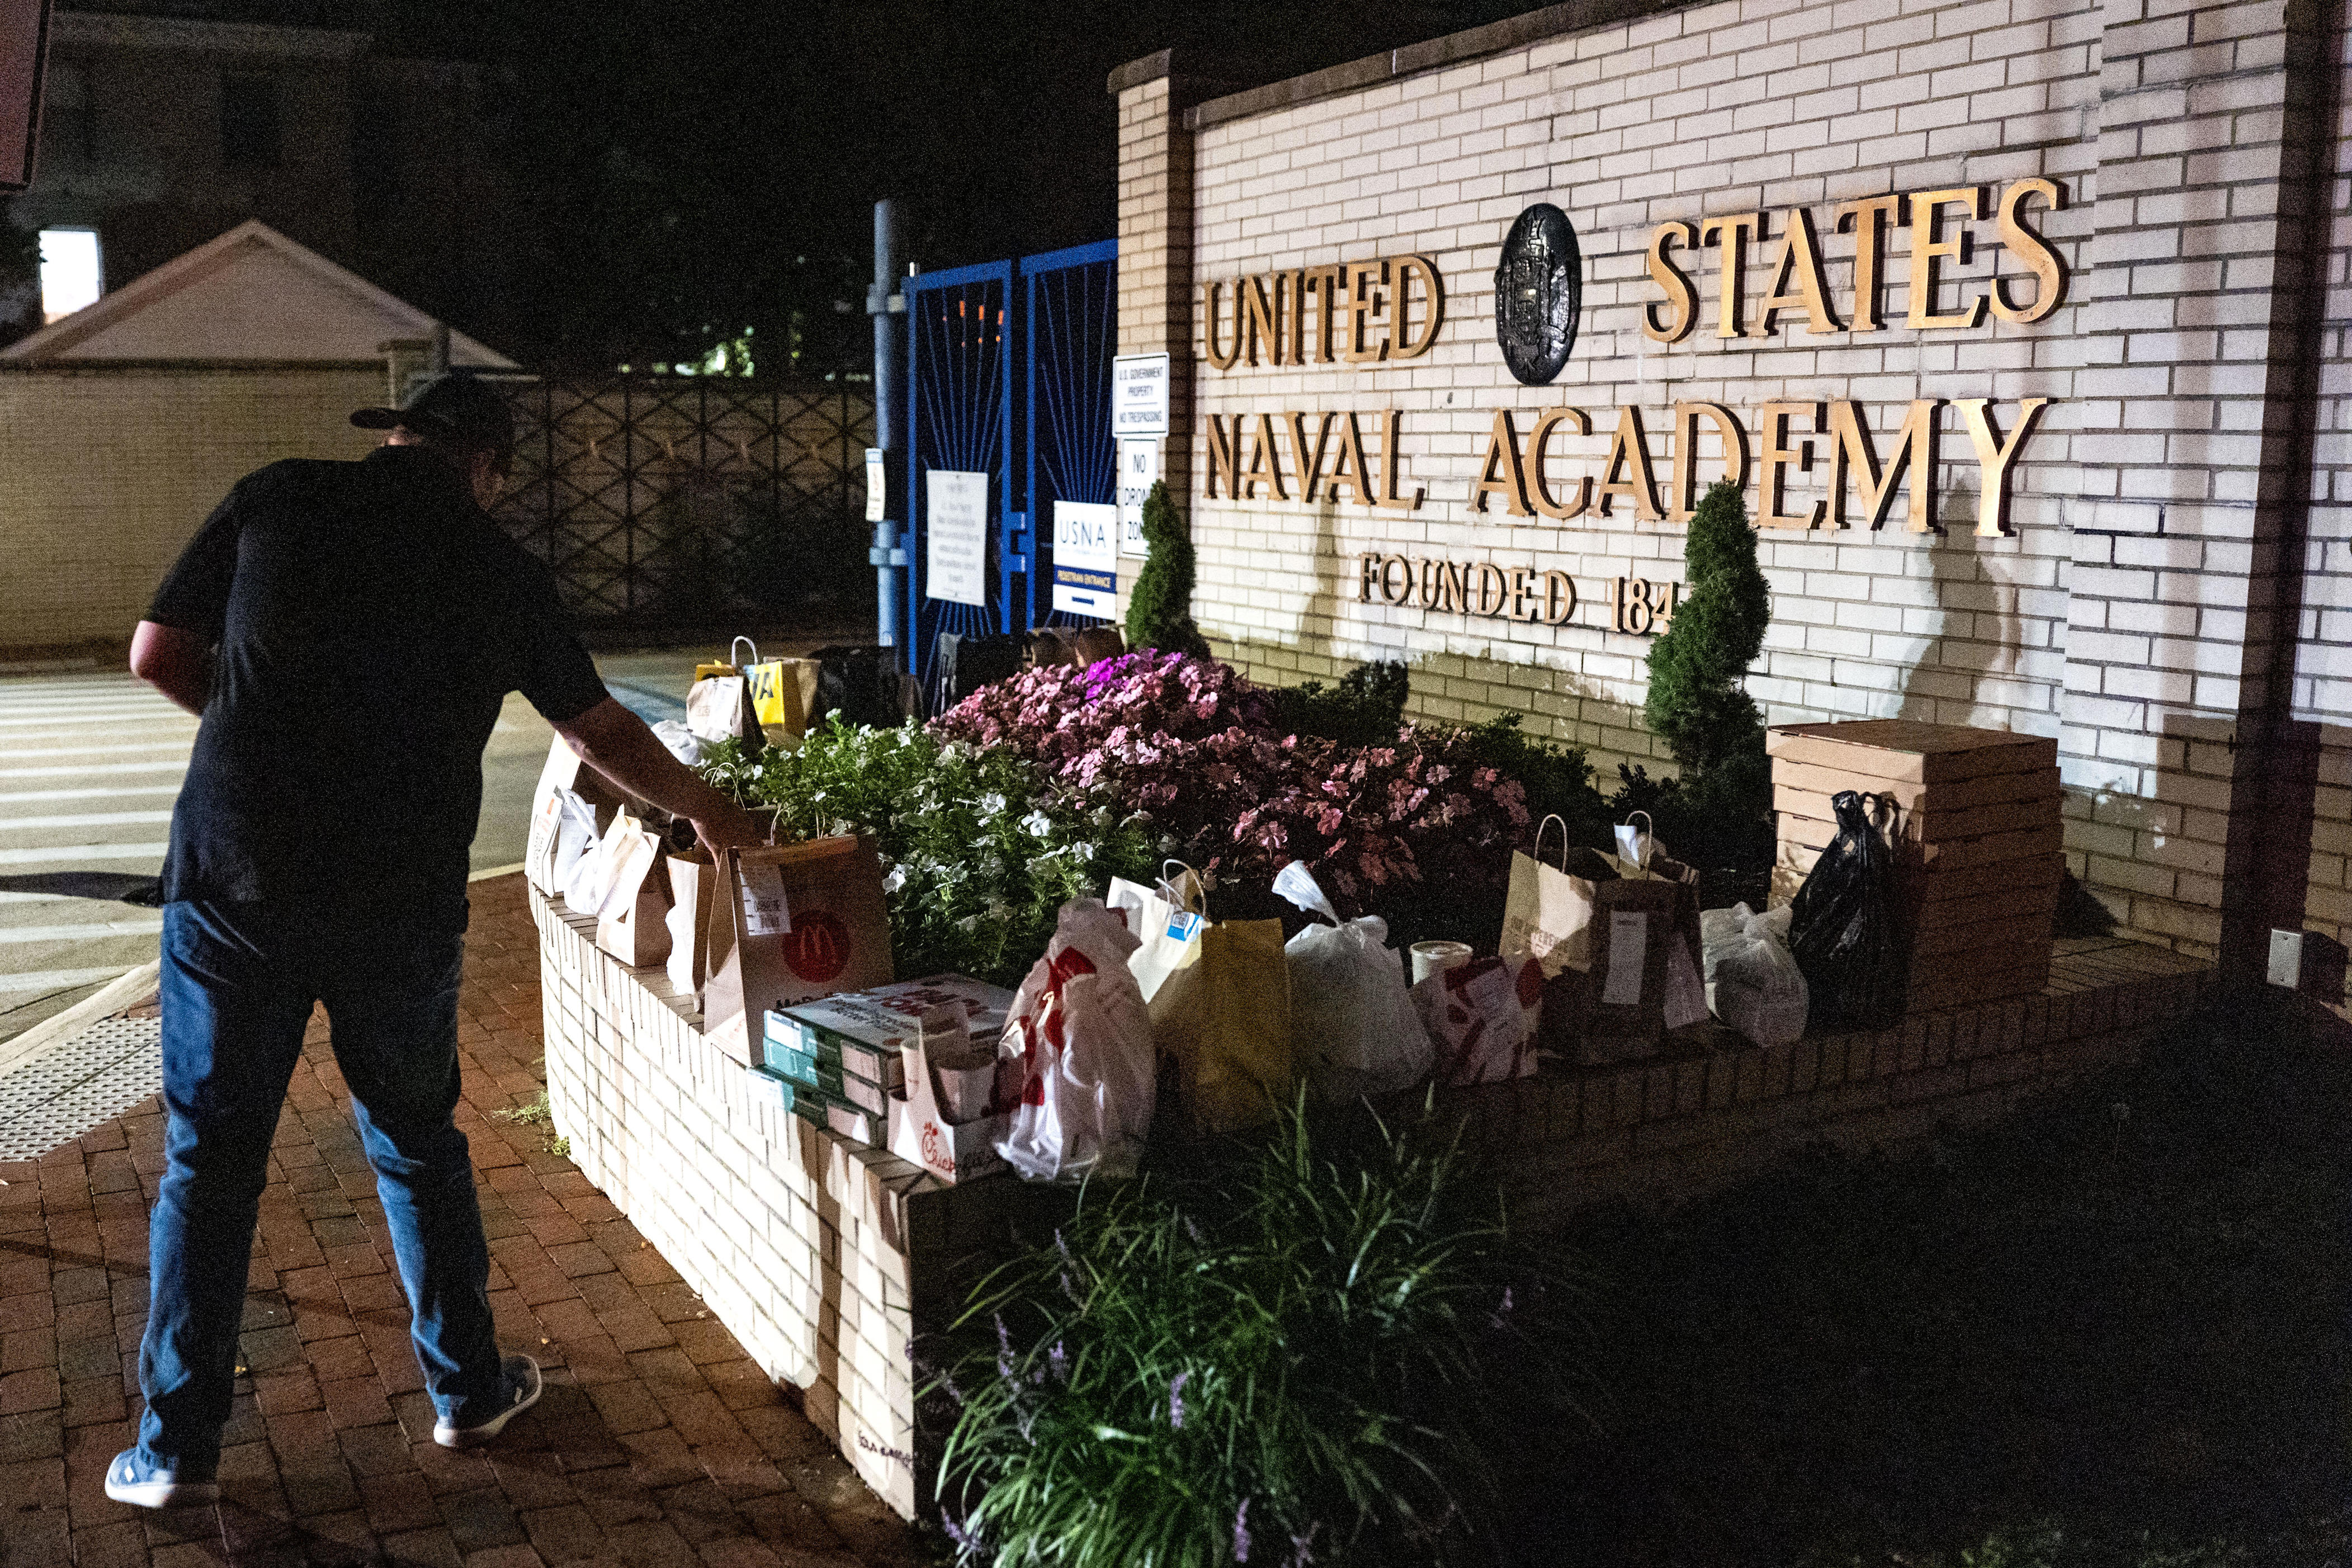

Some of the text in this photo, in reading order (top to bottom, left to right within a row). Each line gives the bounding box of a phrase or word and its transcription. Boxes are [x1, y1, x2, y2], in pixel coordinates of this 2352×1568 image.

[1203, 176, 2071, 372] UNITED STATES
[1133, 454, 1146, 474] NO
[1203, 396, 2057, 539] NAVAL ACADEMY
[1124, 487, 1150, 507] DRON
[1059, 519, 1107, 549] USNA
[1359, 552, 1679, 636] FOUNDED 184
